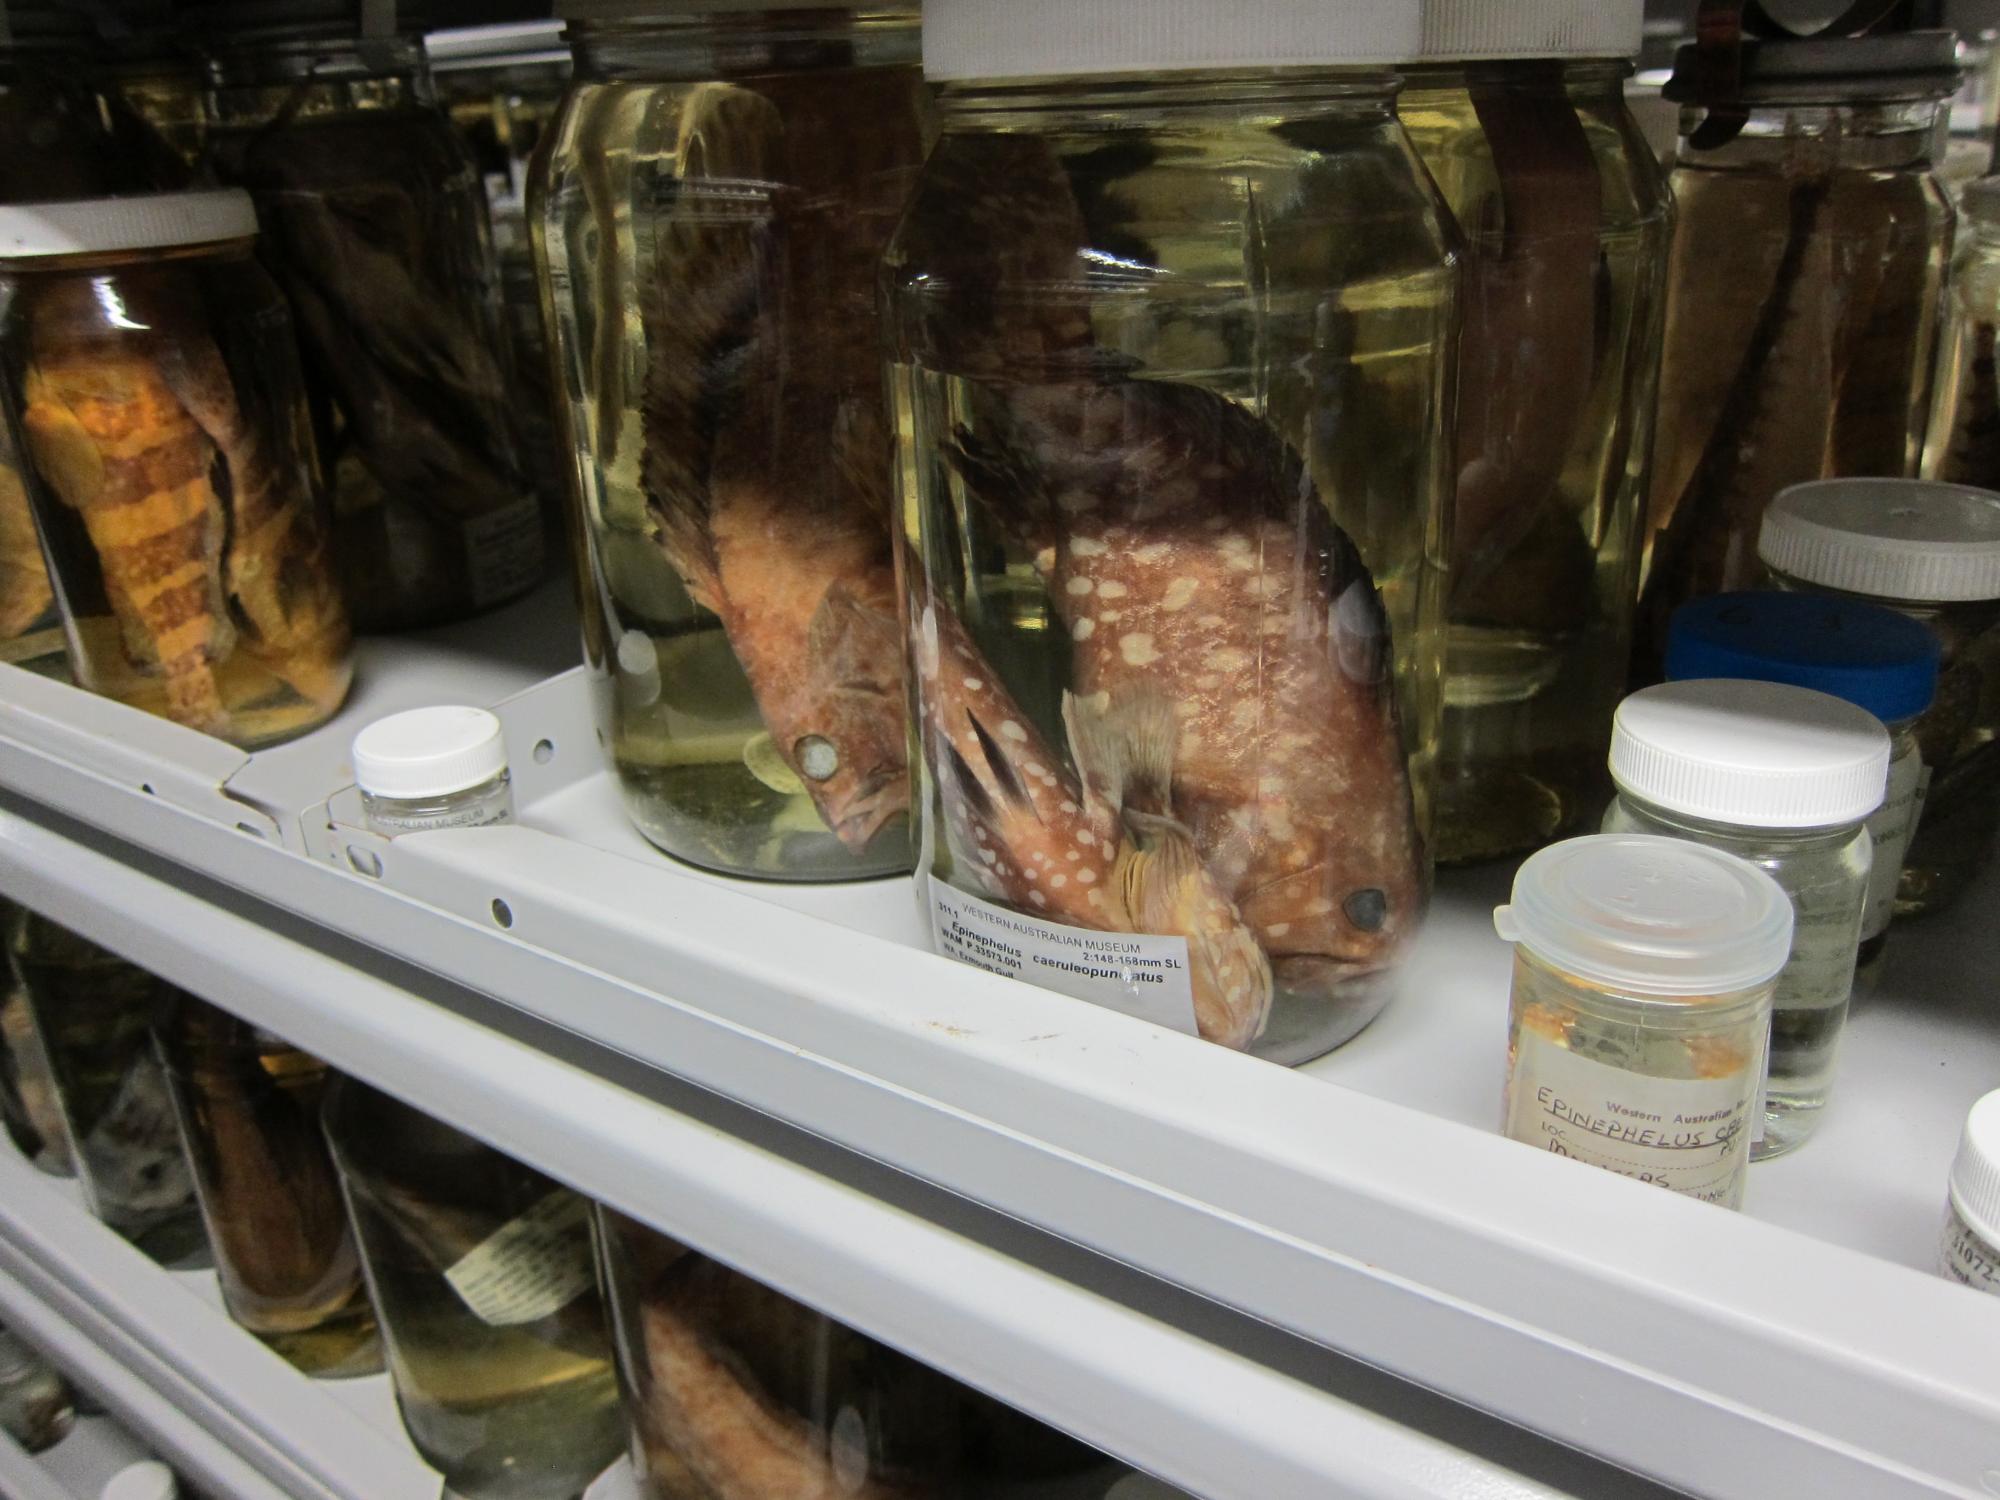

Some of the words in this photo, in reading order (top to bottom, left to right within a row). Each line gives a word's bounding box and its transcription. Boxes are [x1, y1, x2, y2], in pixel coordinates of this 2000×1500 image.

[941, 927, 963, 946] WAM
[952, 921, 1022, 958] Epinephelus
[962, 903, 1011, 929] WESTERN
[1013, 922, 1082, 948] AUSTRALIAN
[1085, 939, 1141, 954] MUSEUM
[1165, 959, 1181, 969] SL
[1538, 1087, 1704, 1147] EPINEPHELUS
[1605, 1101, 1661, 1122] Western
[1673, 1109, 1732, 1125] Australian
